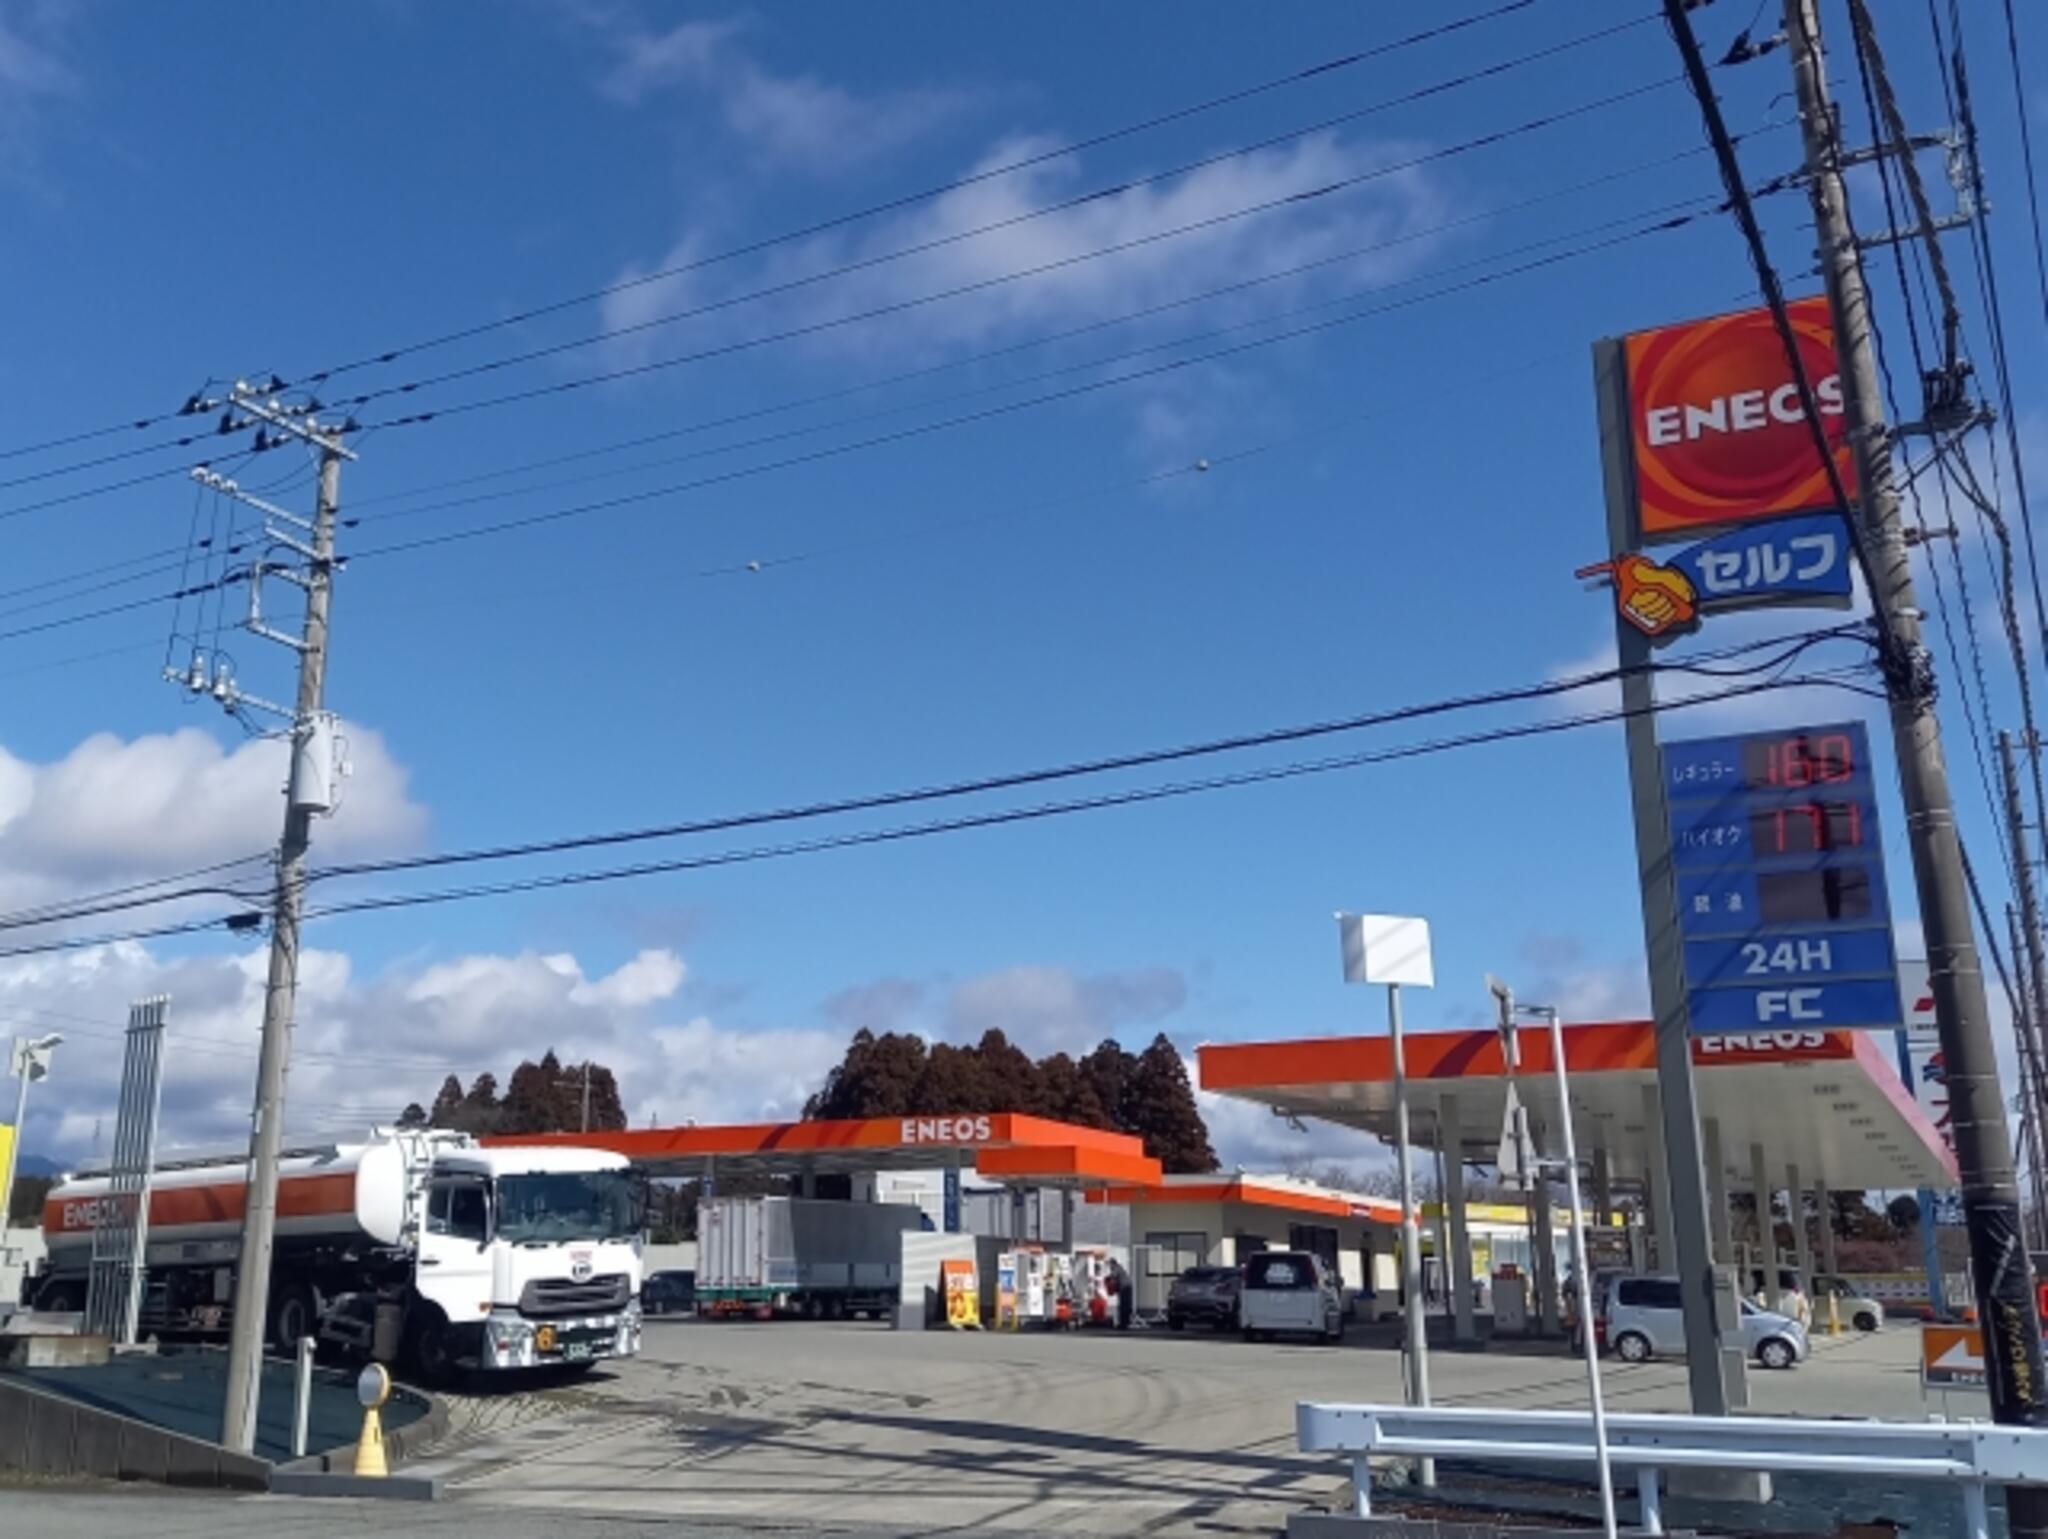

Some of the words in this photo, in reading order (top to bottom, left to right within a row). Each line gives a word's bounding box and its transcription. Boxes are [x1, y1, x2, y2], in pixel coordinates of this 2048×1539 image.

[1646, 373, 1845, 446] ENEOS
[1695, 533, 1836, 592] セルフ
[1768, 734, 1852, 787] 160
[1741, 939, 1831, 974] 24H
[1756, 988, 1824, 1022] FC
[901, 1116, 992, 1143] ENEOS
